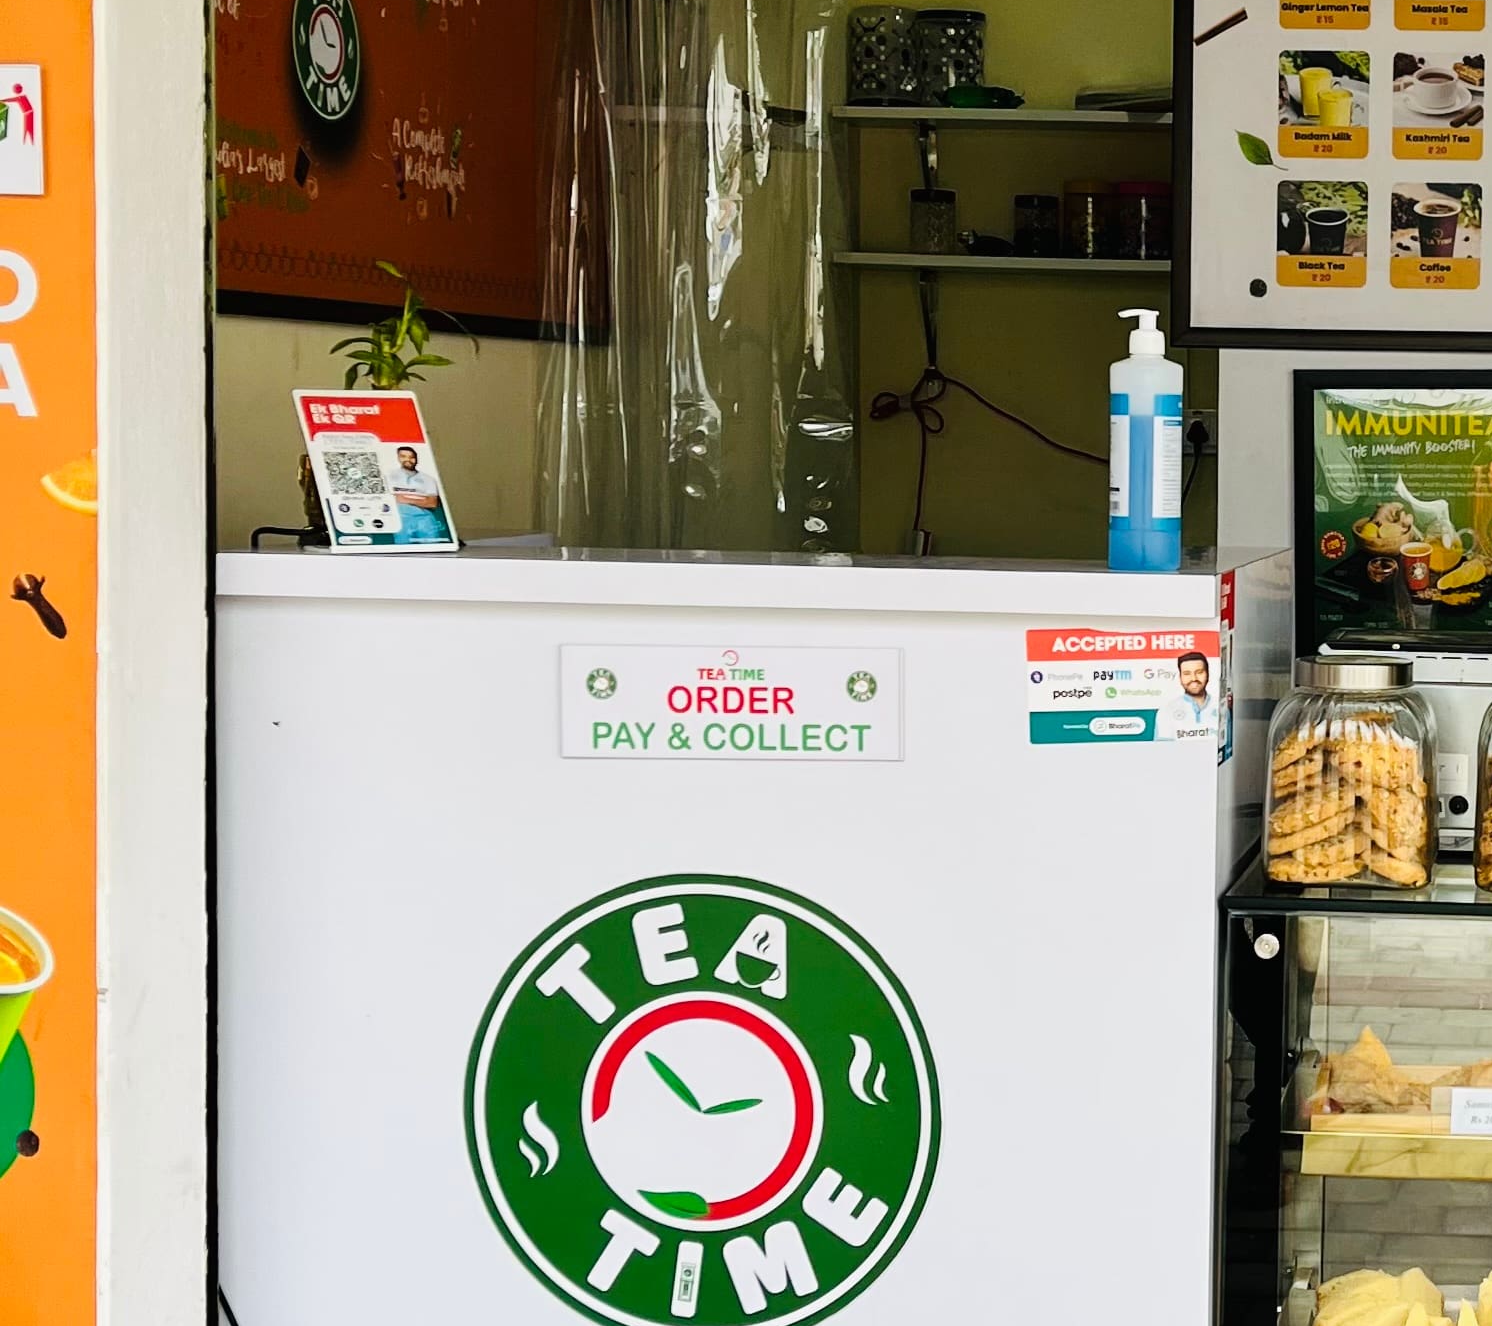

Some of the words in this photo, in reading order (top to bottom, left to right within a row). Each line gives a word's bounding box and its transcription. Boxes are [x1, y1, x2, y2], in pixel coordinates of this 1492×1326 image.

[306, 66, 351, 113] TIME
[1406, 134, 1448, 144] Kashmiri
[1452, 134, 1470, 144] Tea
[1298, 262, 1324, 270] Black
[1327, 262, 1345, 270] Tea
[1419, 264, 1451, 273] Coffee
[1347, 445, 1368, 458] THE
[1052, 636, 1147, 652] ACCEPTED
[1152, 635, 1194, 649] HERE
[697, 668, 726, 680] TEA
[729, 669, 764, 681] TIME
[668, 686, 794, 714] ORDER
[592, 723, 655, 749] PAY
[668, 723, 691, 750] &
[704, 723, 871, 752] COLLECT
[535, 903, 787, 1024] TEA
[587, 1167, 889, 1318] TIME
